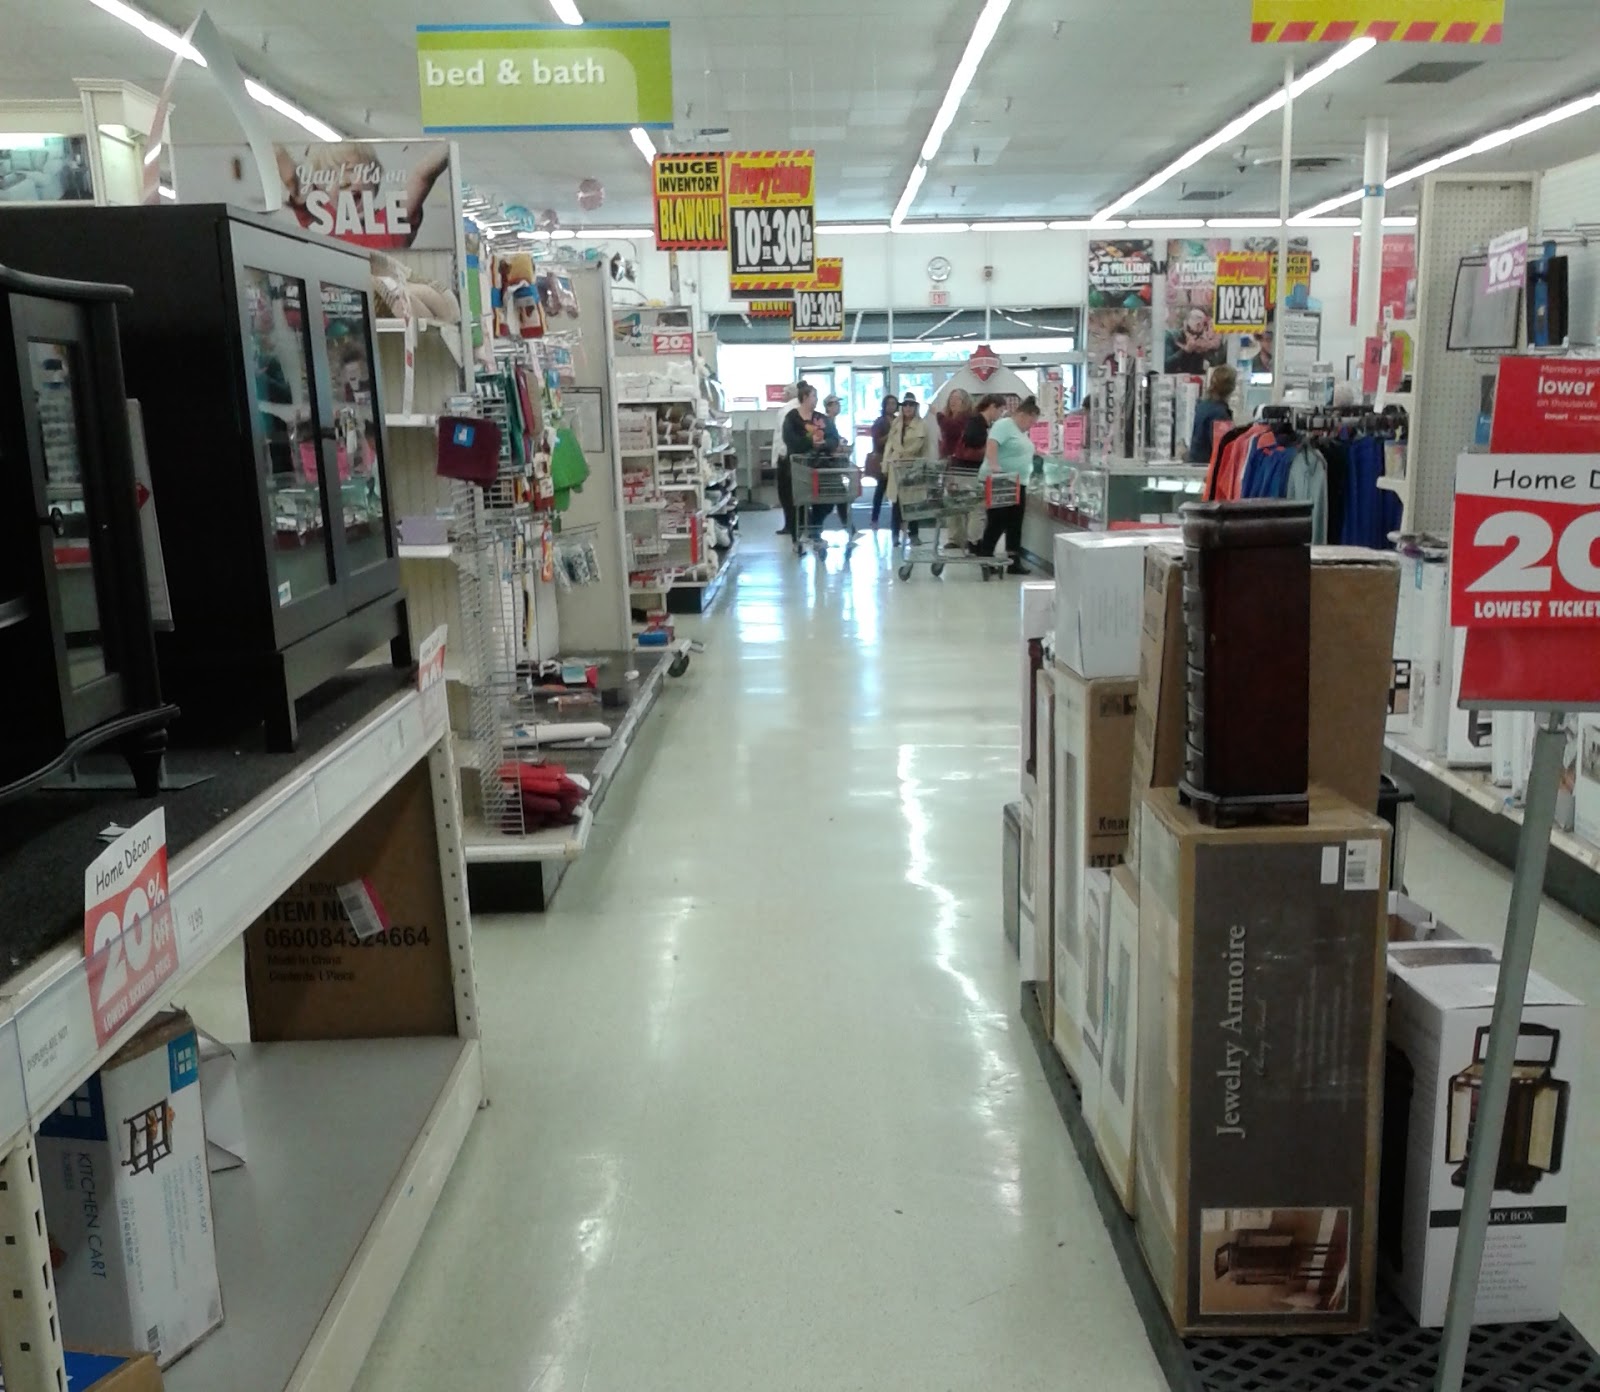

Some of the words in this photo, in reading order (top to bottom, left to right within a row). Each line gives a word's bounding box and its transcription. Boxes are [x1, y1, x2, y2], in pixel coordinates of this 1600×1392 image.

[425, 58, 485, 87] bed
[497, 58, 522, 85] &
[532, 57, 606, 85] bath
[660, 161, 718, 174] HUGE
[659, 176, 719, 192] INVENTORY
[305, 190, 412, 236] SALE
[1537, 376, 1595, 396] lower
[1493, 469, 1577, 490] Home
[1474, 601, 1542, 618] LOWEST
[95, 861, 125, 895] Home
[124, 834, 152, 868] Décor
[264, 901, 316, 922] ITEM
[1219, 924, 1246, 1033] Armoire
[1216, 1041, 1250, 1139] Jewelry
[78, 1151, 100, 1229] KITCHEN
[1510, 1211, 1534, 1220] BOX
[88, 1234, 107, 1280] CART
